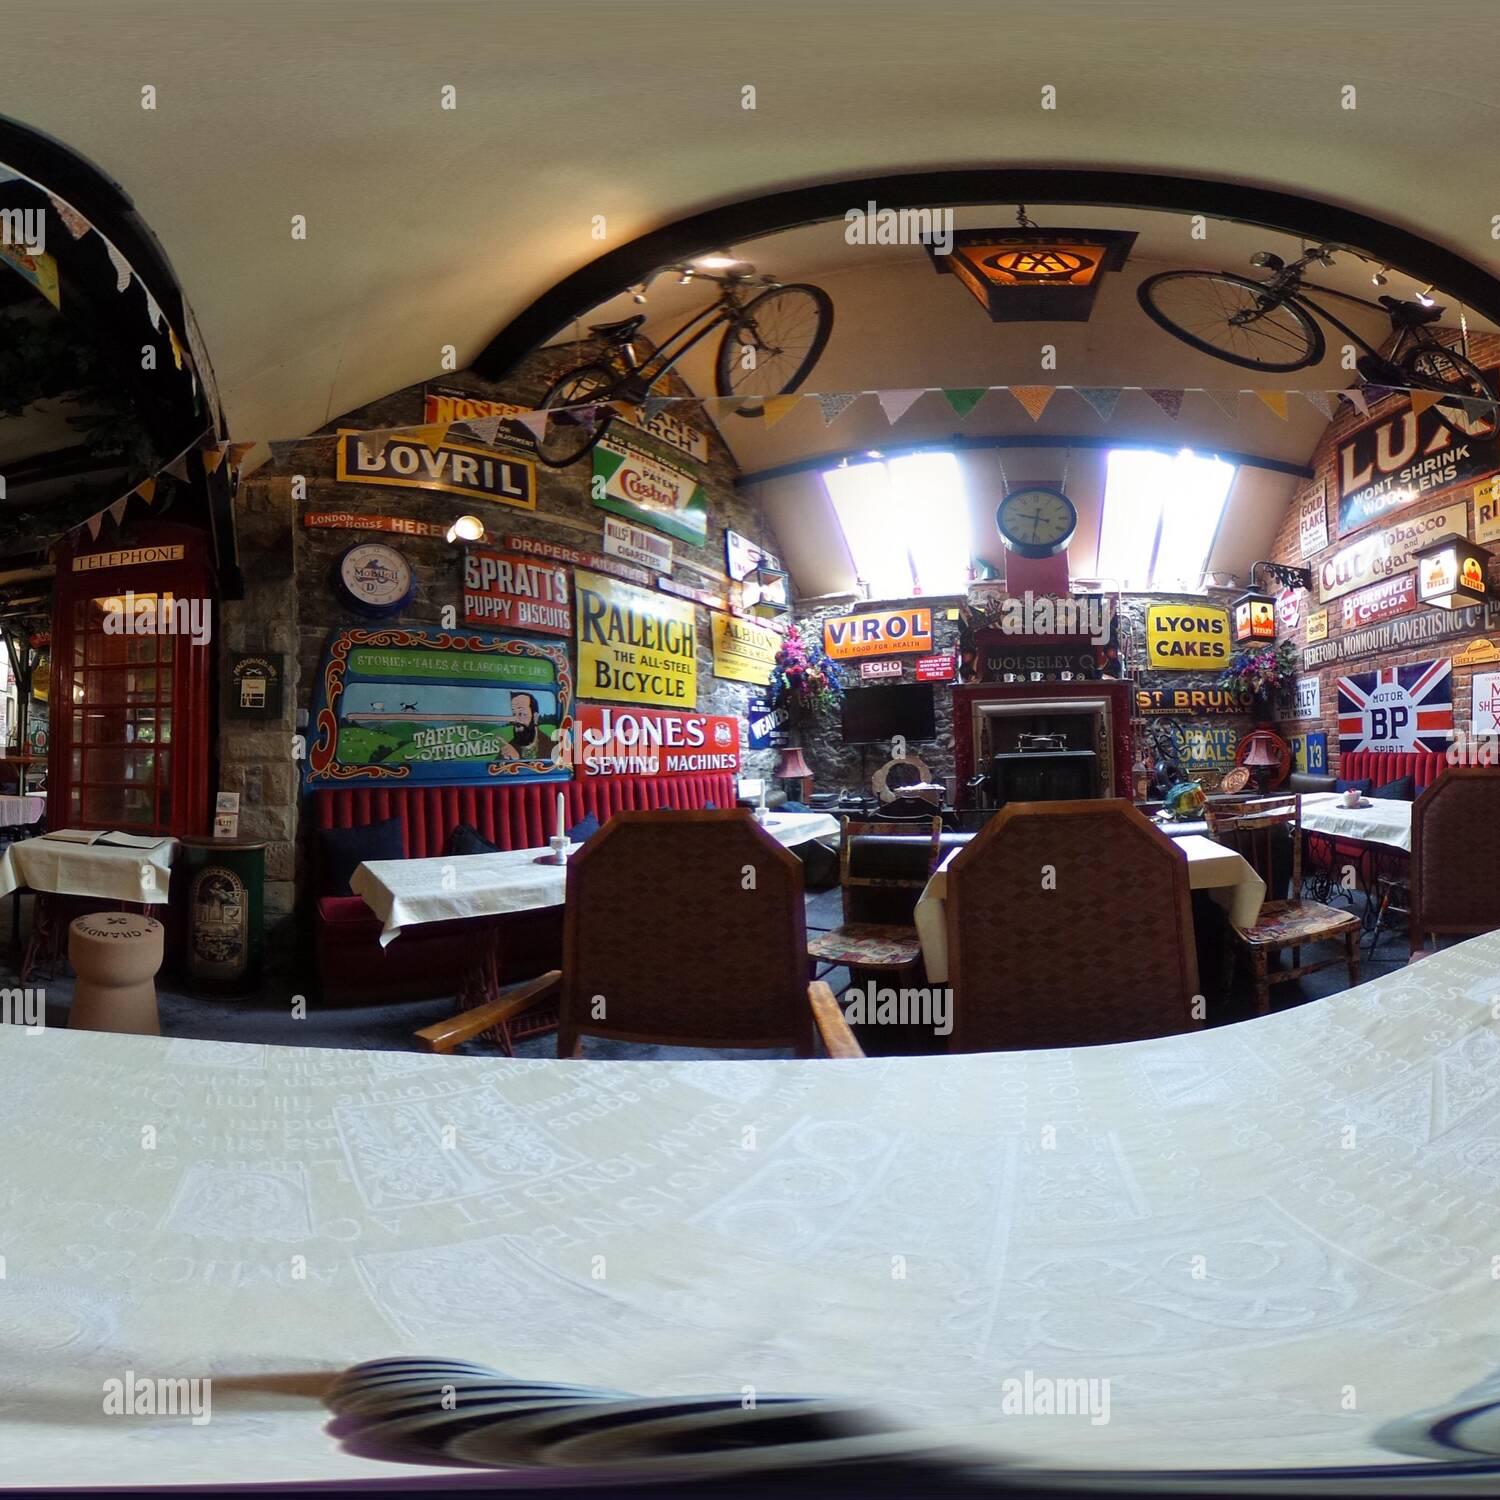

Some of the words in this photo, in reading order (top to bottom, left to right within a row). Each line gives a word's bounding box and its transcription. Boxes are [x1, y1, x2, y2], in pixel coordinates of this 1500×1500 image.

[358, 441, 522, 495] BOVRIL
[1399, 445, 1471, 484] SHRINK
[1479, 486, 1495, 498] ASK
[1301, 496, 1324, 518] GOLD
[311, 514, 354, 525] LONDON
[346, 519, 384, 530] HOUSE
[1300, 509, 1325, 535] FLAKE
[1382, 515, 1448, 548] Tobacco
[511, 538, 580, 562] DRAPERS
[1403, 538, 1420, 550] and
[77, 547, 179, 570] TELEPHONE
[1343, 577, 1414, 619] BOURNVILLE
[1359, 594, 1408, 619] COCOA
[464, 594, 512, 619] PUPPY
[518, 601, 571, 630] BISCUITS
[578, 588, 695, 658] RALEIGH
[828, 613, 931, 645] VIROL
[1303, 642, 1338, 670] HEREFORD
[1343, 628, 1391, 657] MONMOUTH
[1391, 610, 1463, 646] ADVERTISING
[1155, 640, 1226, 658] CAKES
[1453, 656, 1477, 666] SHELL
[613, 650, 636, 664] THE
[640, 657, 692, 675] ALL-STEEL
[863, 661, 900, 673] ECHO
[986, 654, 1075, 671] WOLSELEY
[594, 660, 686, 698] BICYCLE
[1174, 690, 1252, 708] BRUNO
[1372, 690, 1404, 703] MOTOR
[1205, 706, 1252, 715] FLAKE
[412, 725, 472, 750] TAFFY
[583, 708, 706, 749] JONES'
[420, 737, 501, 761] THOMAS
[1373, 744, 1405, 753] SPIRIT
[584, 756, 660, 776] SEWING
[666, 753, 737, 773] MACHINES
